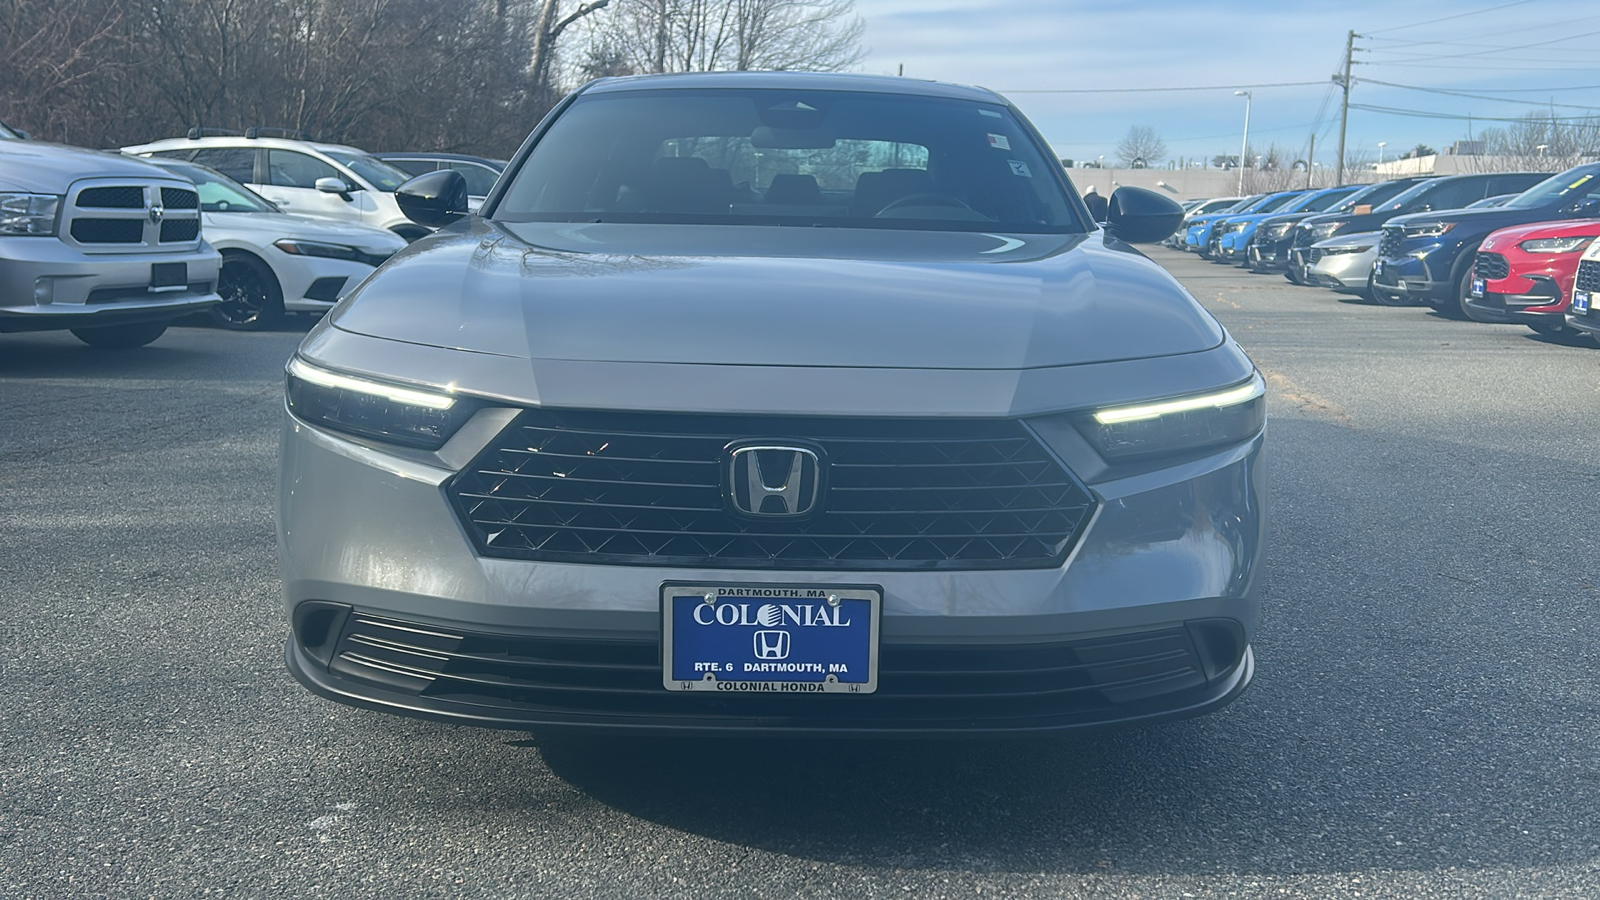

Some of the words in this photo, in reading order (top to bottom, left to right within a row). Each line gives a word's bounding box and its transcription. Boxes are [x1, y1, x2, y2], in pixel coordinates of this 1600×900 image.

[806, 590, 826, 598] MA
[693, 603, 851, 627] COLONIAL
[694, 662, 722, 672] RTE.
[725, 662, 734, 672] 6
[743, 662, 826, 674] DARTMOUTH,
[829, 663, 848, 673] MA
[716, 681, 778, 691] COLONIAL
[780, 682, 825, 692] HONDA
